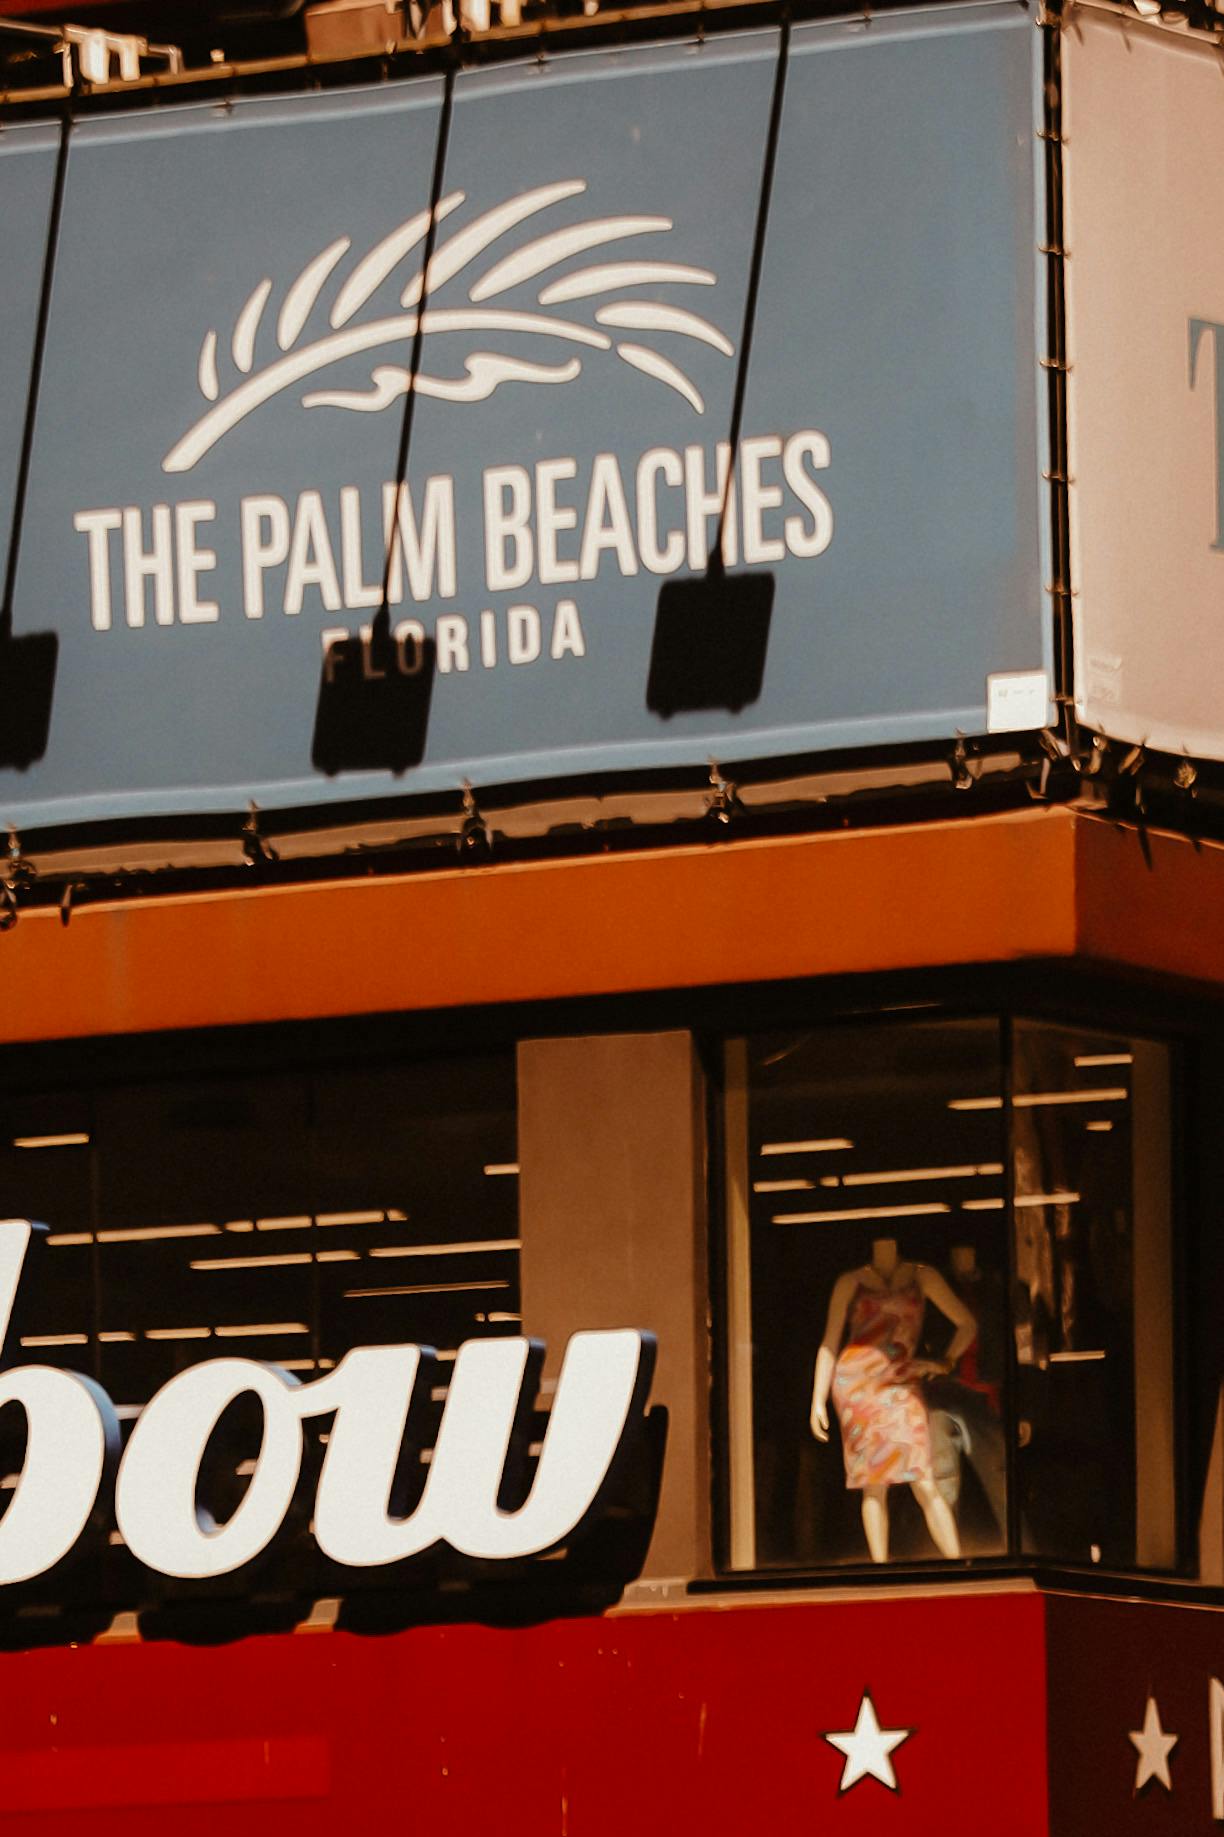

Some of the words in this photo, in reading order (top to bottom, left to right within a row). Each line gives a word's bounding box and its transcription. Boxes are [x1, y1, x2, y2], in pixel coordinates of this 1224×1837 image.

[74, 500, 219, 631] THE
[241, 475, 457, 619] PALM
[484, 430, 834, 591] BEACHES
[320, 600, 587, 684] FLORIDA
